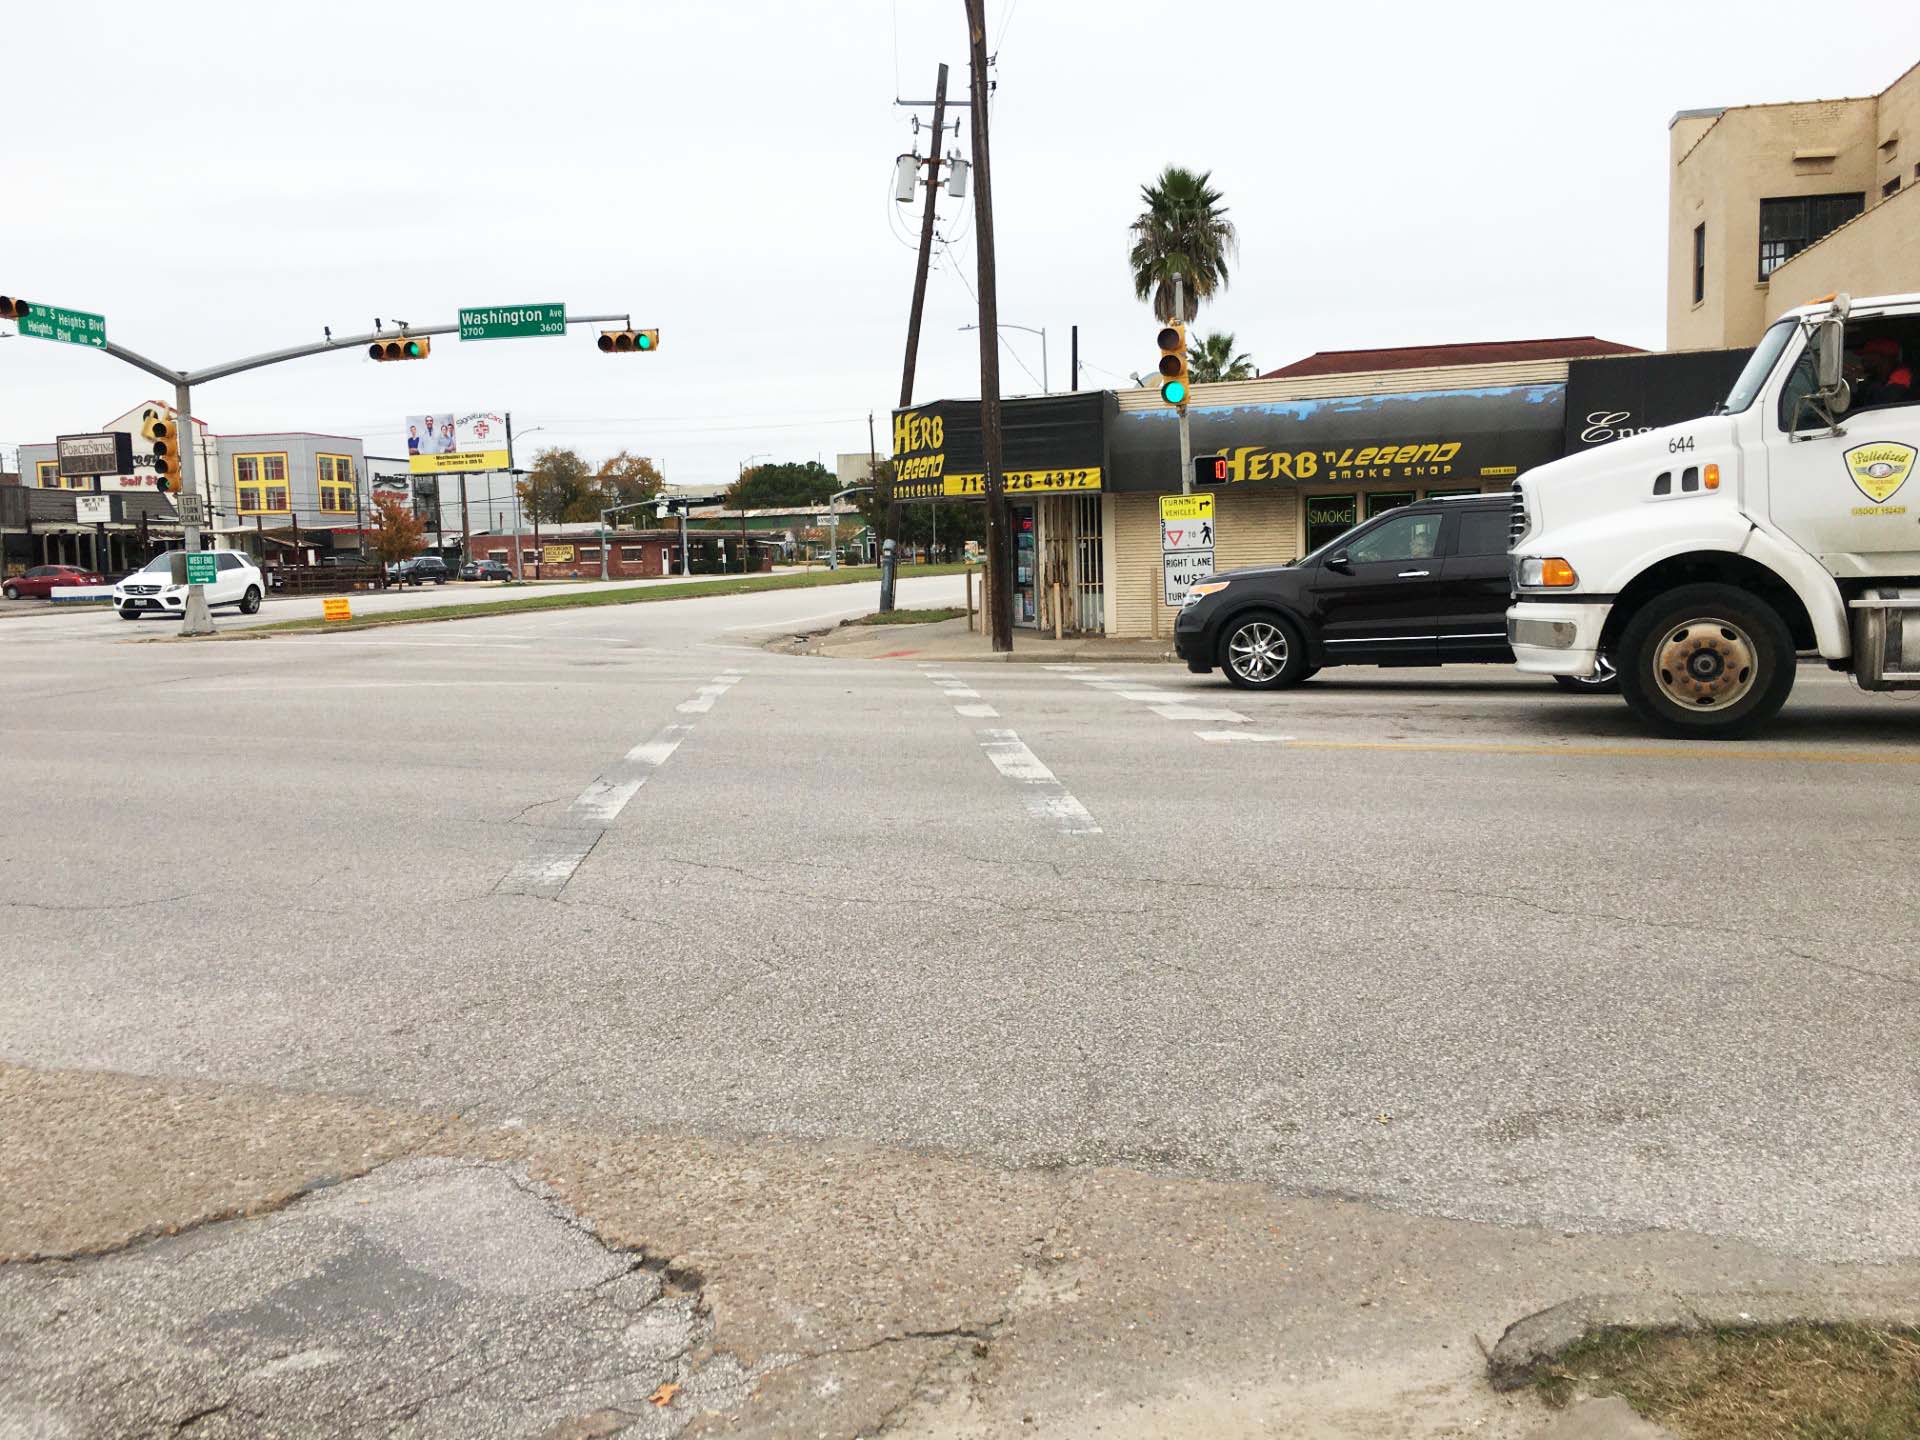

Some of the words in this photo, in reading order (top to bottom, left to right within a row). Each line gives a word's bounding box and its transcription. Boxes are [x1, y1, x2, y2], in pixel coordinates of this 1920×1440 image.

[50, 308, 56, 320] S
[58, 313, 86, 331] Heights
[88, 318, 104, 332] Blvd
[461, 309, 543, 326] Washington
[549, 309, 562, 318] Ave
[27, 320, 53, 336] Heights
[57, 329, 72, 342] Blvd
[462, 327, 484, 337] 3700
[540, 323, 563, 332] 3600
[893, 411, 944, 455] HERB
[1669, 435, 1695, 454] 644
[1217, 446, 1318, 483] HERB
[182, 497, 197, 505] LEFT
[1164, 498, 1197, 506] TURNING
[180, 514, 201, 522] SIGNAL
[1165, 509, 1197, 517] VEHICLES
[1309, 509, 1352, 525] SMOKE
[1187, 530, 1197, 538] TO
[1166, 558, 1188, 569] RIGHT
[1191, 557, 1212, 567] LANE
